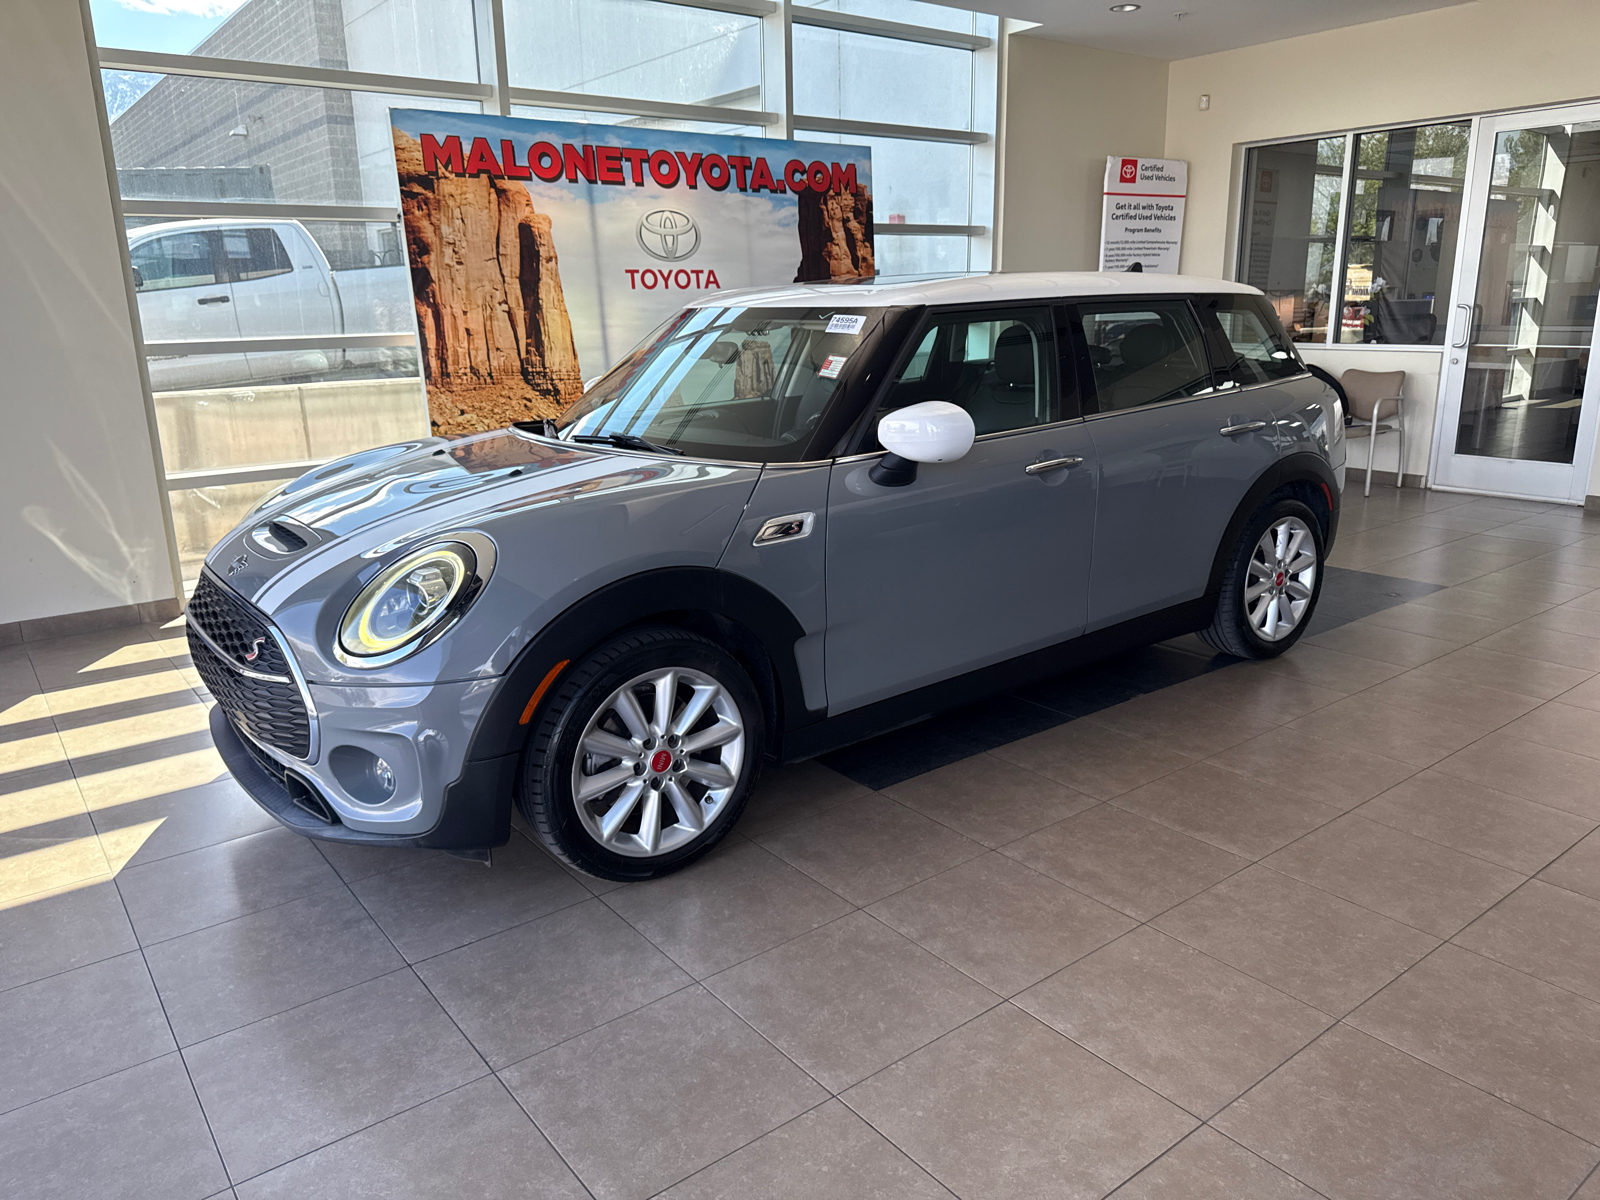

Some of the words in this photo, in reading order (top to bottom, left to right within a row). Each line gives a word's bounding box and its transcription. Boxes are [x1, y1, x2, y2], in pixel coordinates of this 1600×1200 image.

[420, 133, 857, 194] MALONETOYOTA.COM
[1141, 164, 1164, 172] Certified
[1140, 173, 1154, 181] Used
[1155, 174, 1176, 182] Vehicles
[1141, 203, 1154, 211] with
[1155, 204, 1173, 212] Toyota
[624, 268, 721, 290] TOYOTA
[656, 752, 667, 770] MINI
